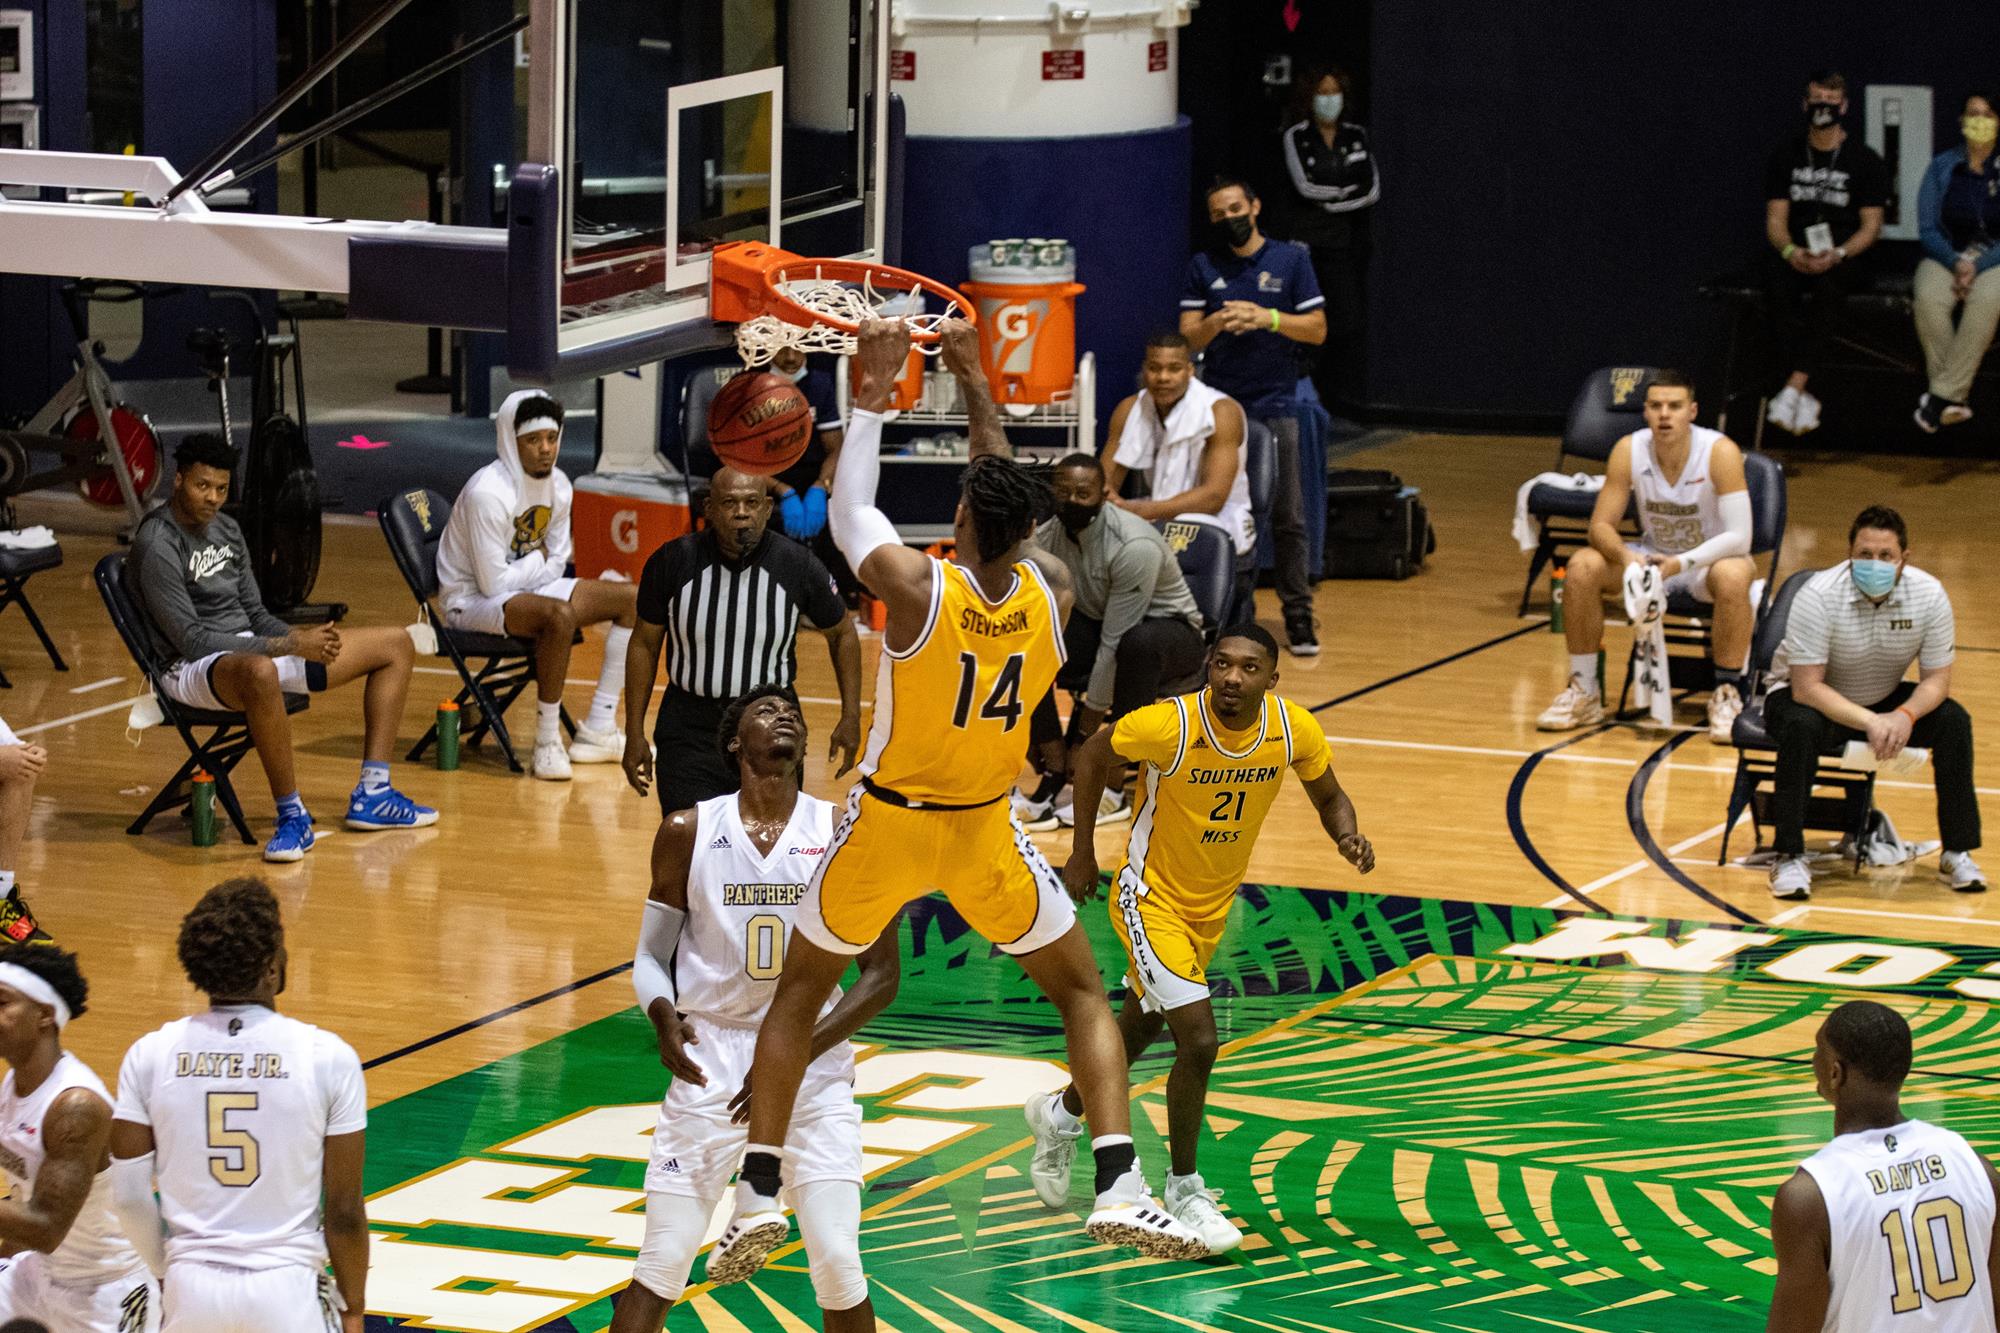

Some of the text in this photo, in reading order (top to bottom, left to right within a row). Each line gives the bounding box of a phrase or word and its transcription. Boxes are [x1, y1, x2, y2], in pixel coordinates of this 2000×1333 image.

[997, 305, 1029, 339] G
[611, 510, 639, 553] G
[960, 607, 1028, 638] STEVENSON
[1890, 619, 1912, 630] FIU
[952, 651, 1025, 734] 14
[1187, 766, 1279, 785] SOUTHERN
[1209, 791, 1247, 822] 21
[1200, 830, 1242, 844] MISS
[746, 914, 785, 981] 0
[1121, 883, 1156, 986] GOLDEN
[176, 1053, 289, 1078] DAYE JR.
[207, 1092, 260, 1187] 5
[1866, 1155, 1947, 1195] DAVIS
[1881, 1196, 1976, 1315] 10
